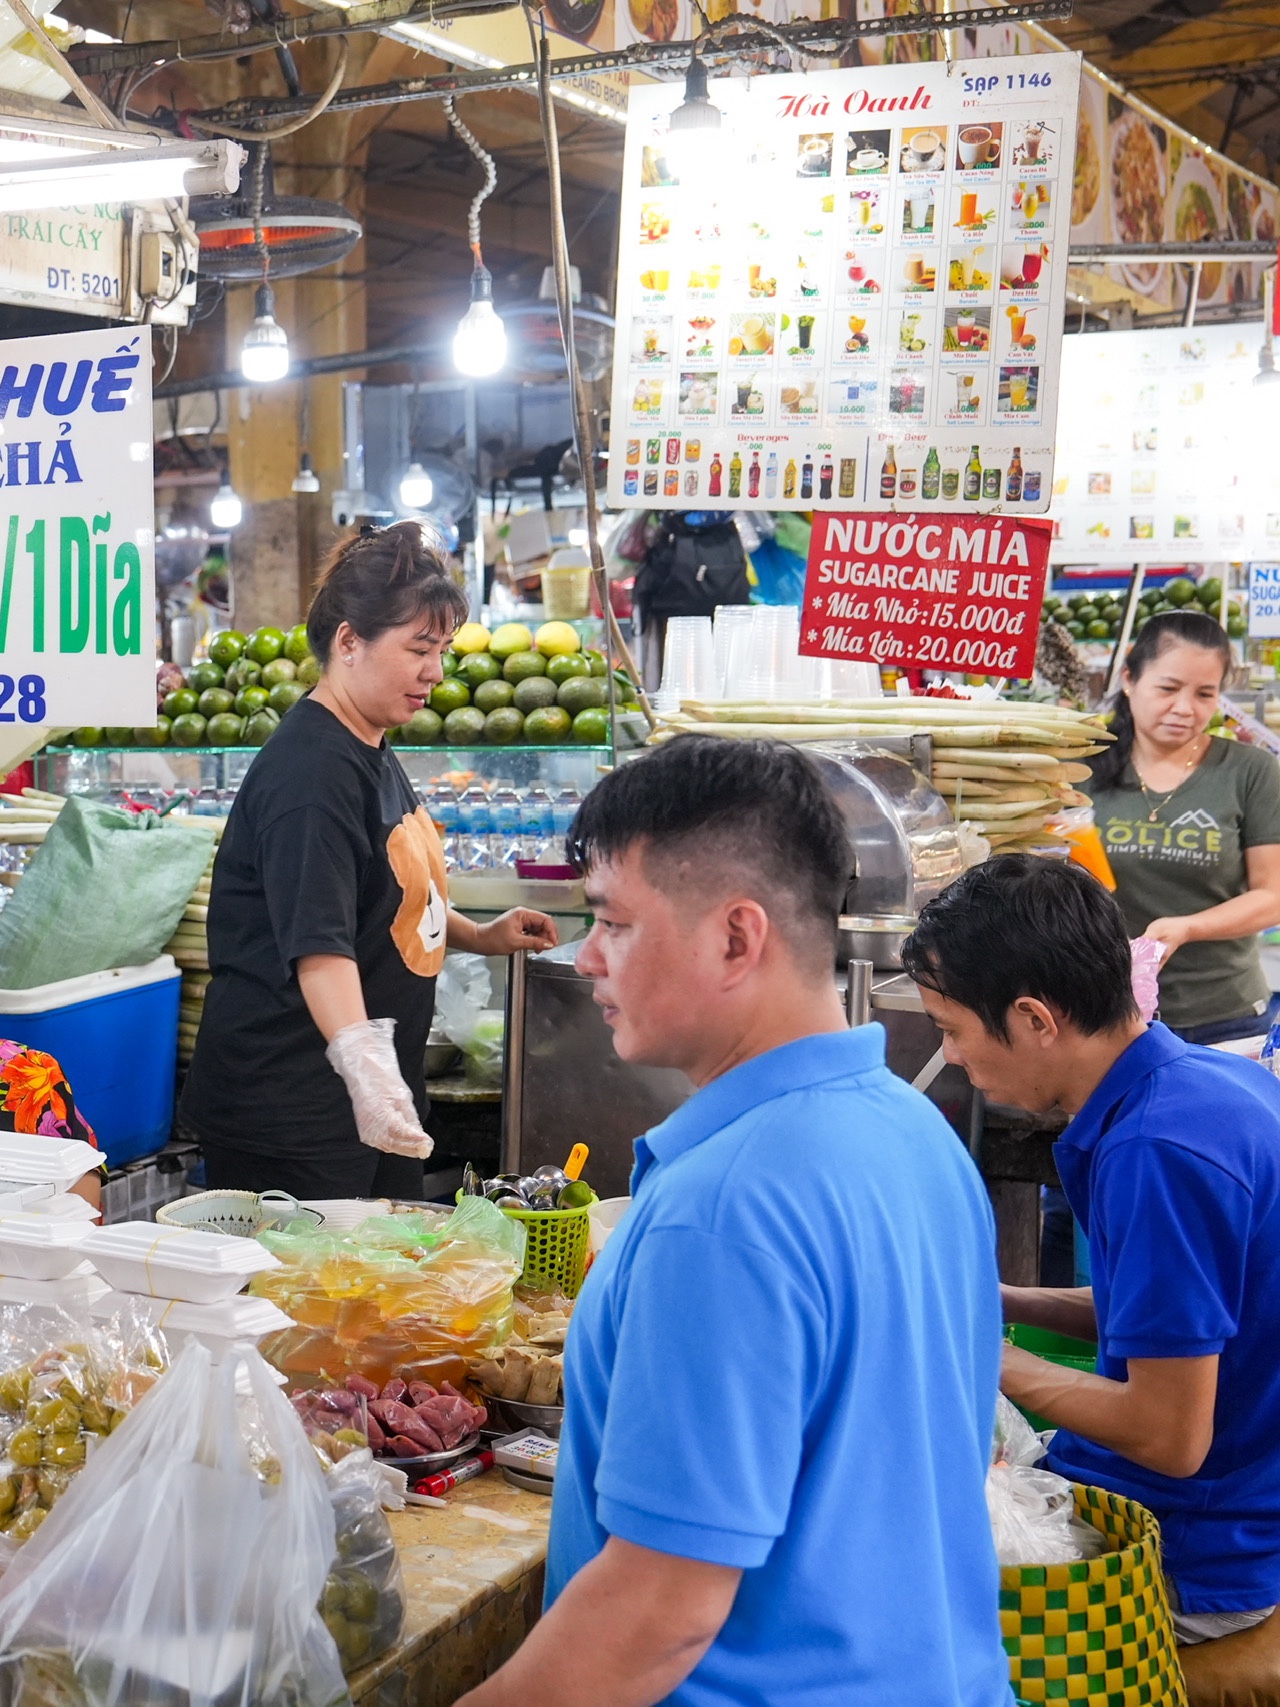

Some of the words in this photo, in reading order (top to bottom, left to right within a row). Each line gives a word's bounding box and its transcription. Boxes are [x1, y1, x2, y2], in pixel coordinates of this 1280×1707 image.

[963, 76, 999, 97] SẠP
[1006, 72, 1053, 91] 1146
[775, 94, 831, 119] Hà
[843, 85, 934, 115] Oanh
[81, 273, 120, 300] 5201
[839, 405, 866, 414] 10.000
[657, 430, 682, 438] 20.000
[737, 433, 790, 443] Beverages
[824, 514, 943, 560] NƯỚC
[947, 520, 1030, 567] MÍA
[818, 559, 960, 594] SUGARCANE
[967, 572, 1032, 600] JUICE
[825, 592, 870, 620] Mía
[1256, 604, 1280, 617] 20.
[820, 626, 865, 653] Mía
[1097, 825, 1223, 853] OLICE
[1106, 843, 1155, 854] SIMPLE
[1160, 846, 1220, 863] MINIMAL
